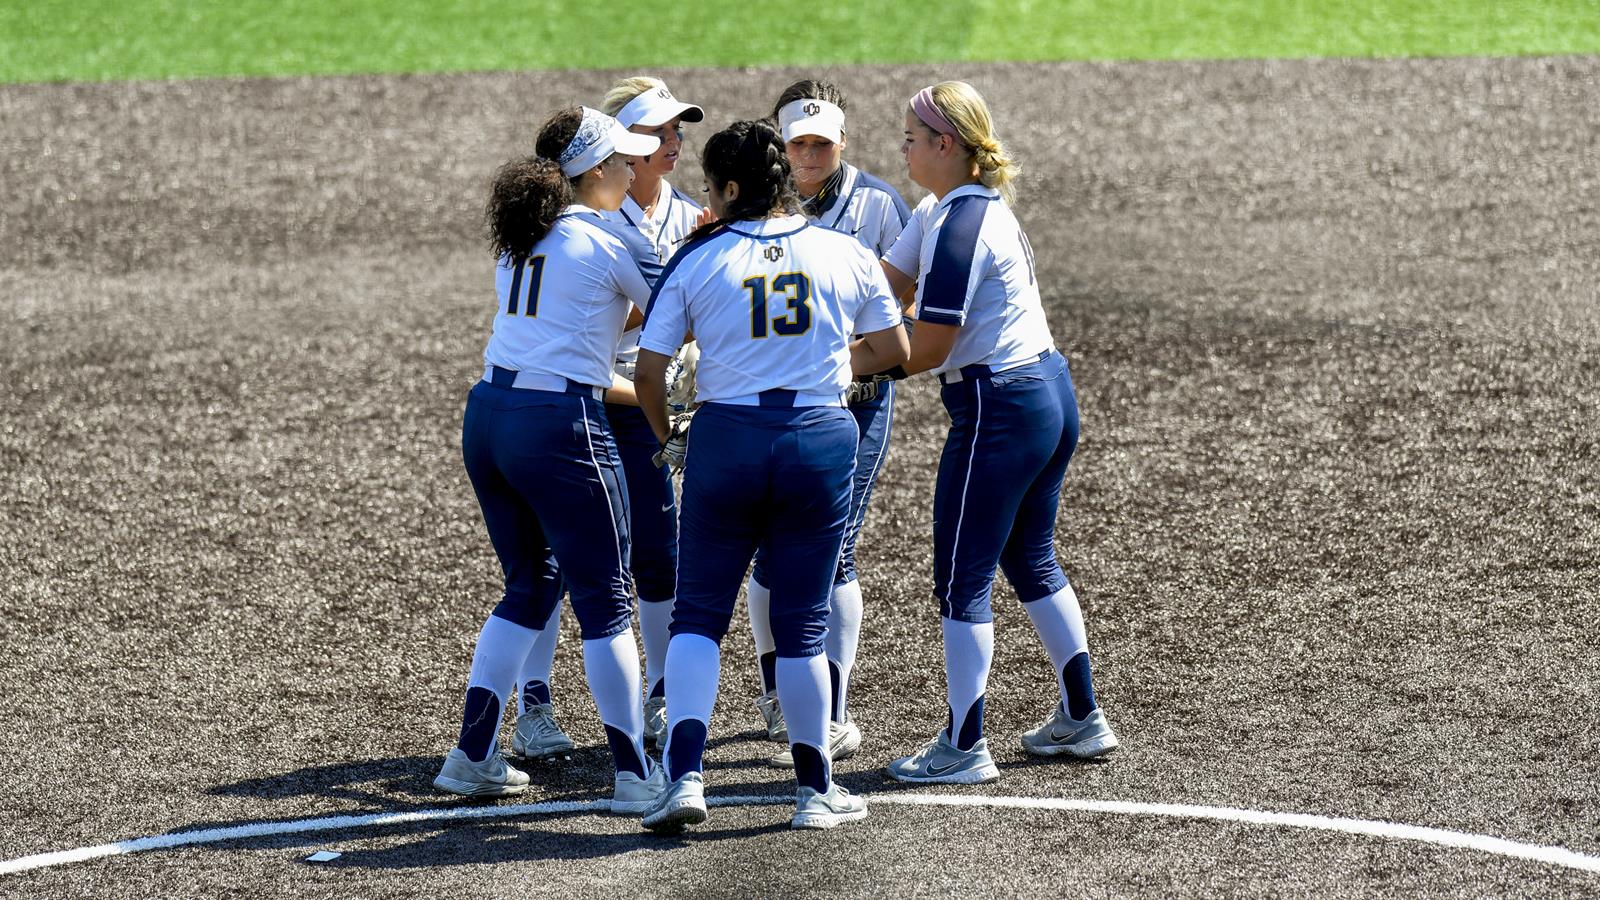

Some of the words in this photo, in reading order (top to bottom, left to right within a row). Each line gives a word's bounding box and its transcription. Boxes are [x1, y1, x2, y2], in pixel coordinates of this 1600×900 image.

[803, 102, 820, 116] UCO
[763, 245, 784, 262] UCO
[506, 253, 547, 318] 11
[742, 271, 812, 339] 13
